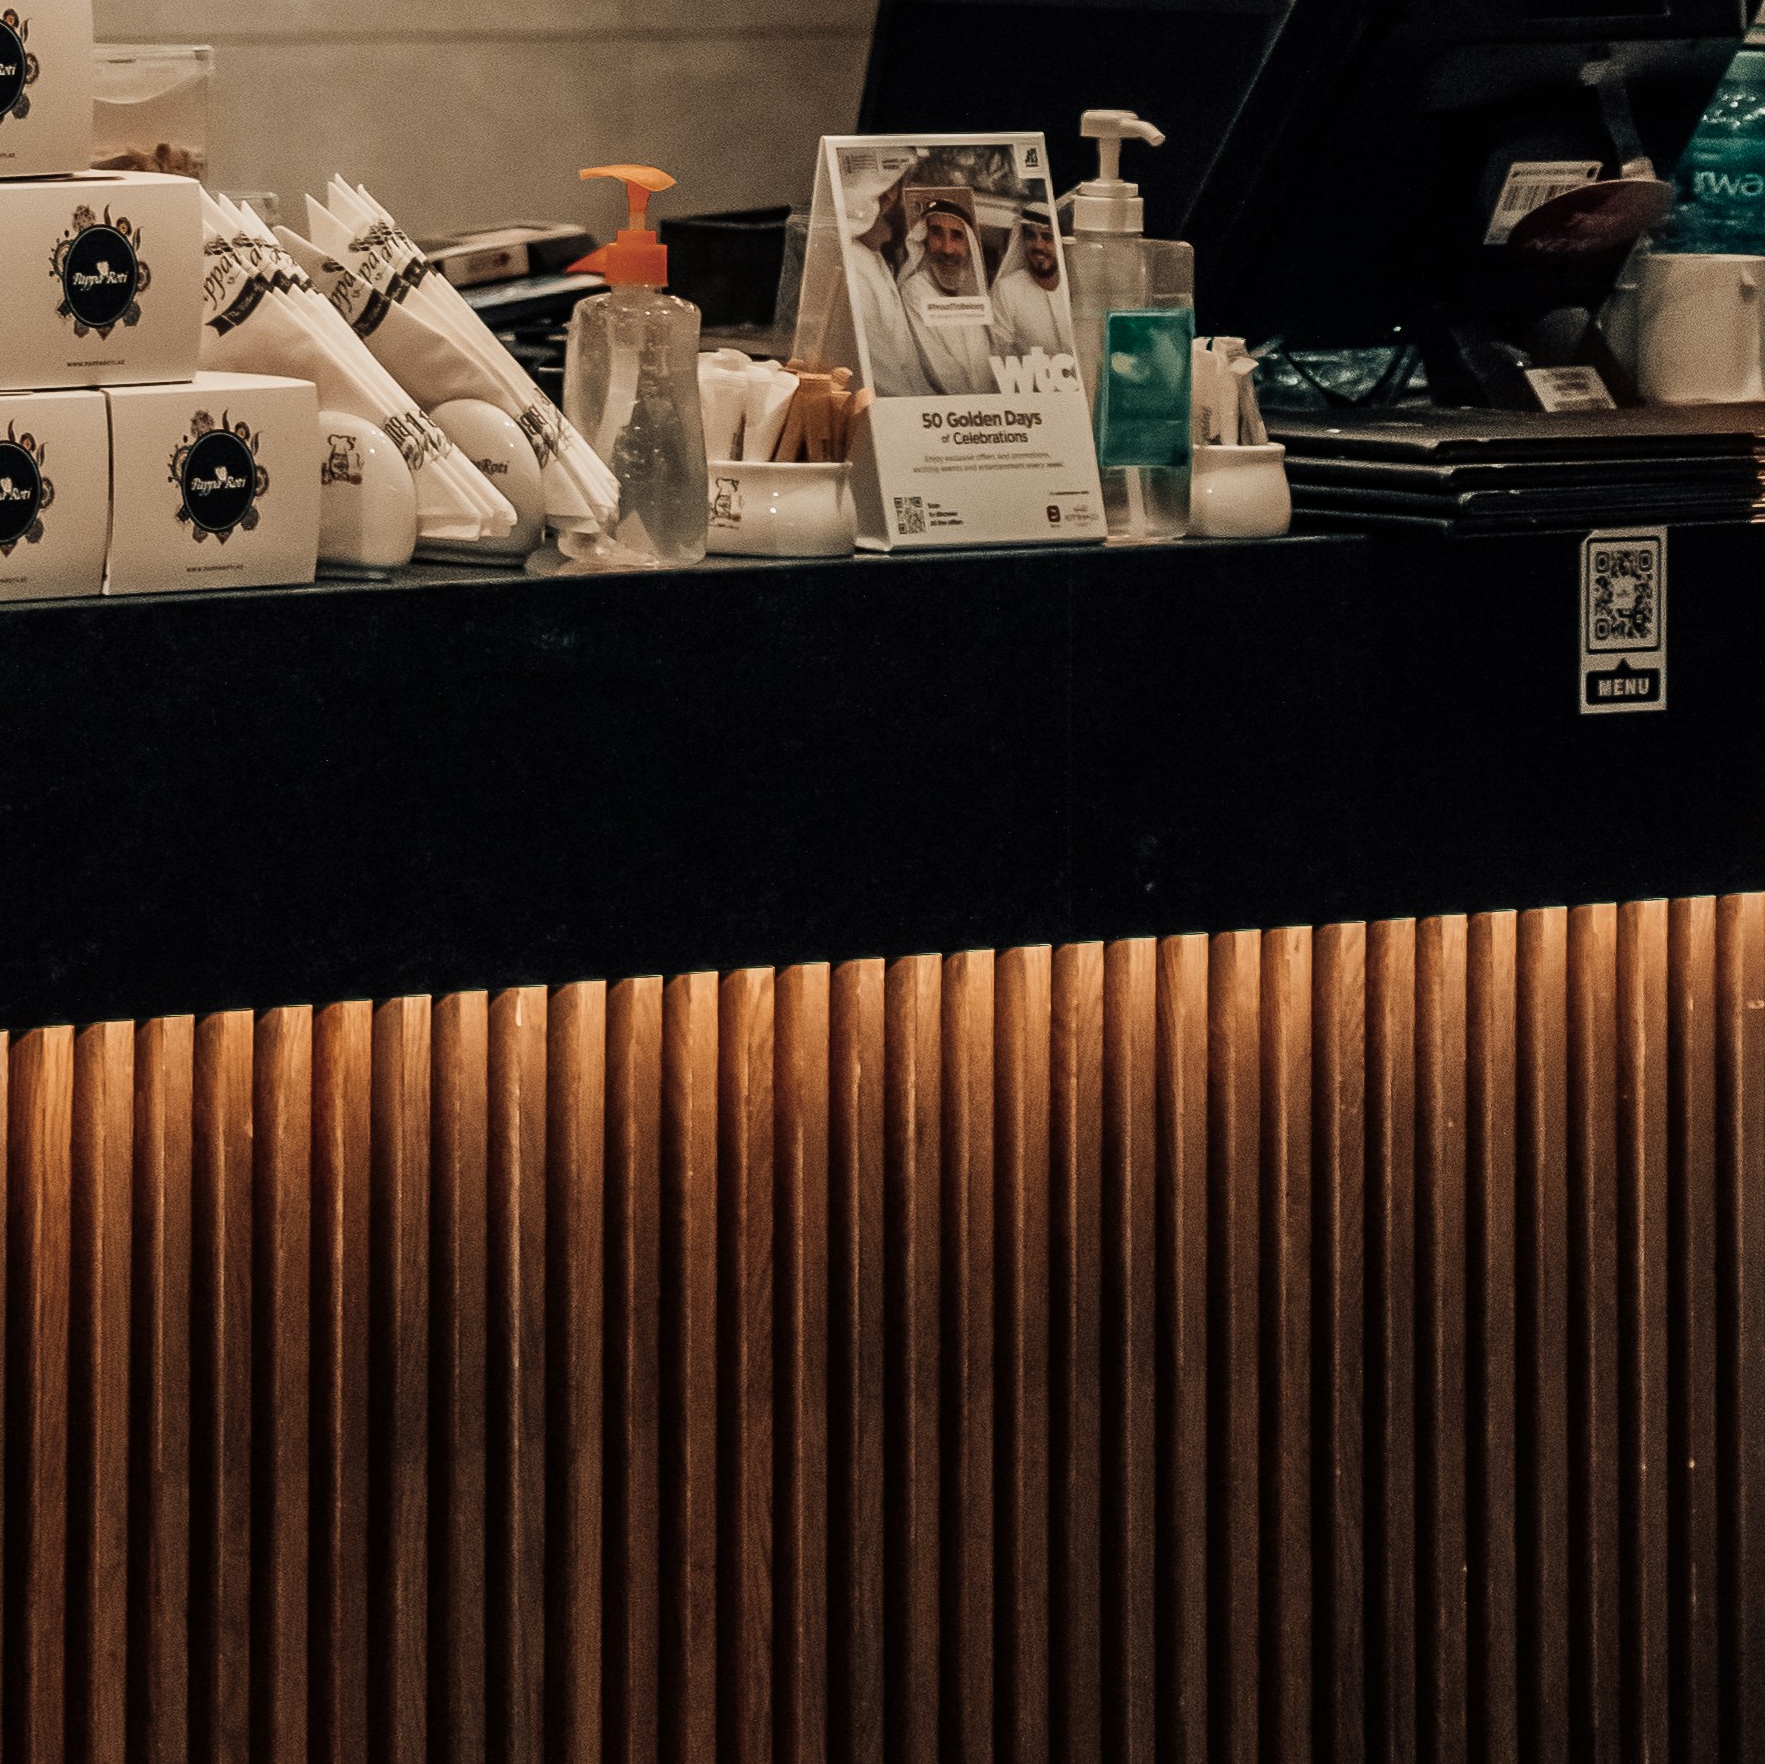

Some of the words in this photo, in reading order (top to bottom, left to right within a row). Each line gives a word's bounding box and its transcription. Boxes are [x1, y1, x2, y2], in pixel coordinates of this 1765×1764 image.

[922, 413, 943, 429] 50
[947, 411, 1002, 428] Golden
[1004, 410, 1043, 429] Days
[941, 434, 951, 443] of
[953, 431, 1029, 445] Celebrations
[1598, 677, 1650, 696] MENU
